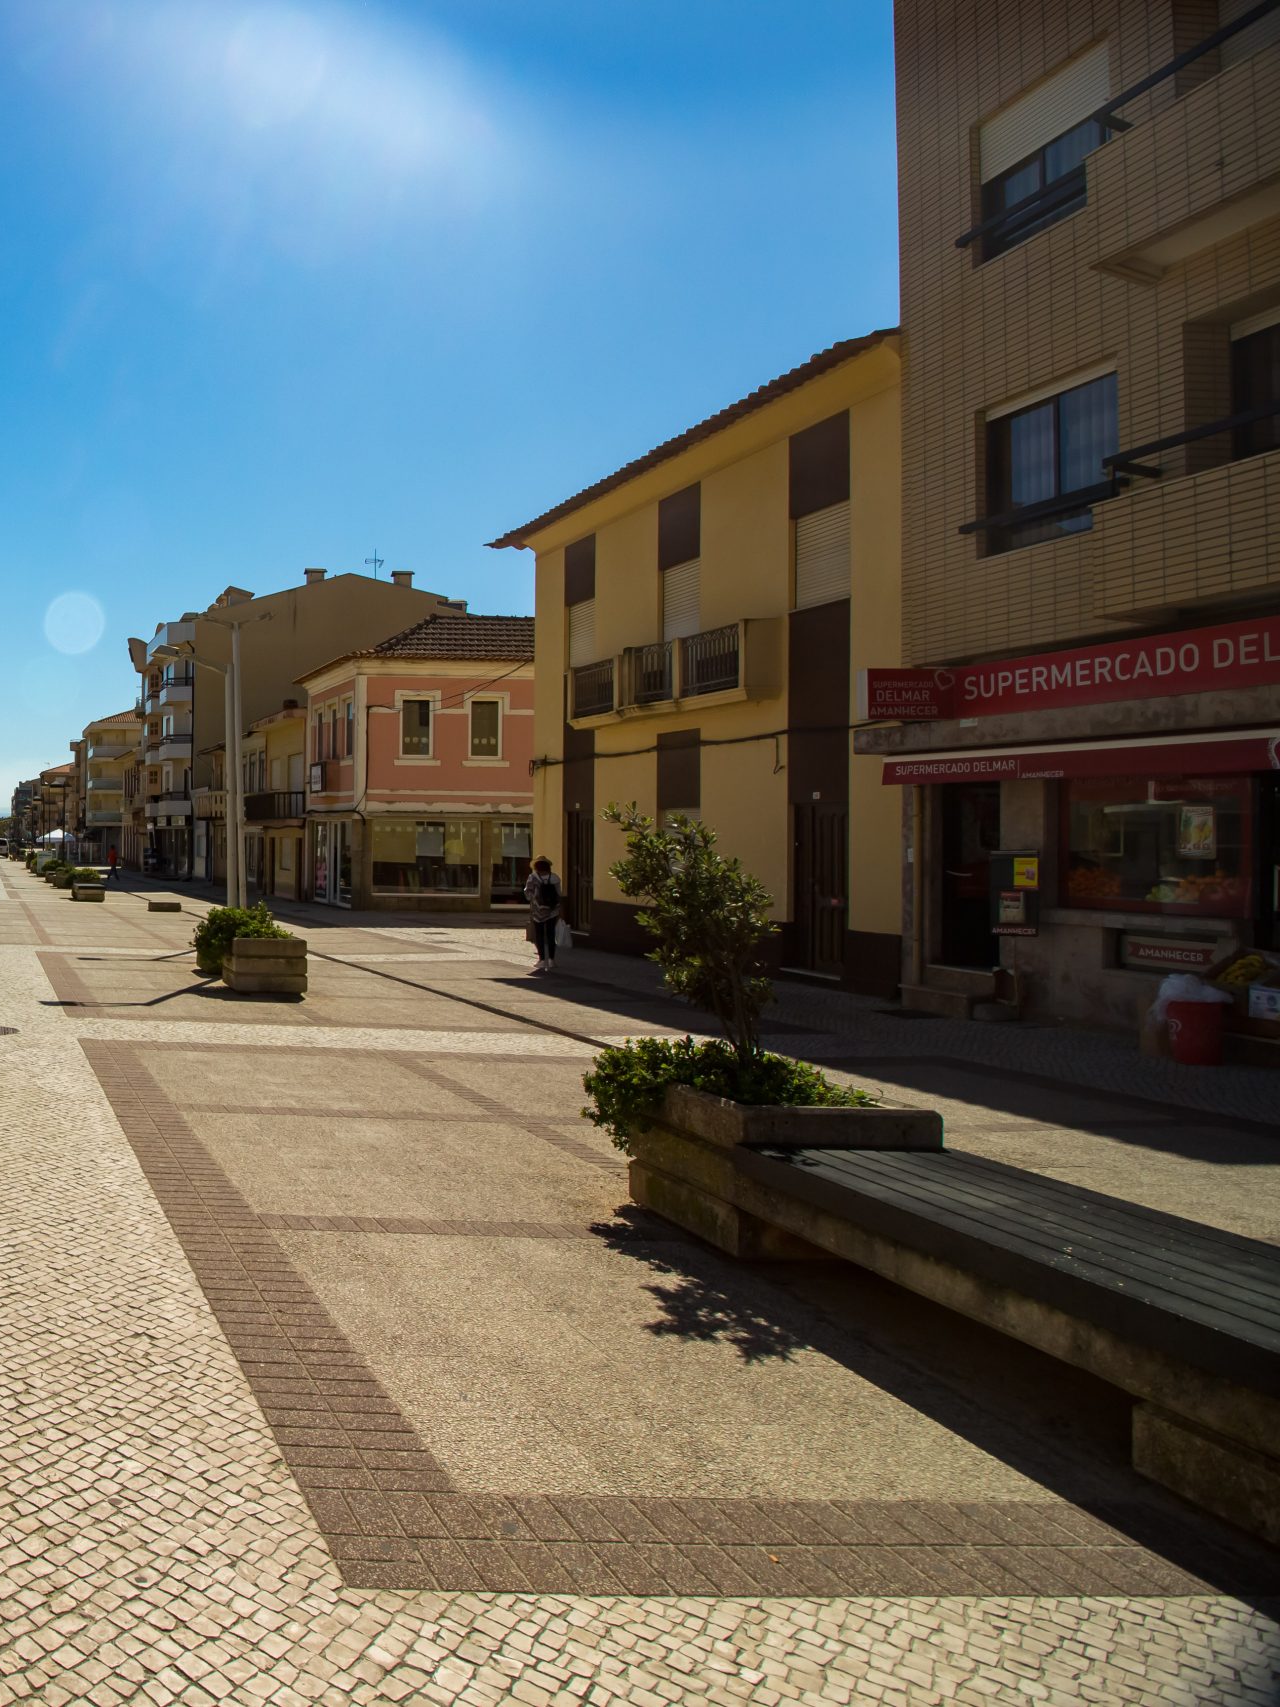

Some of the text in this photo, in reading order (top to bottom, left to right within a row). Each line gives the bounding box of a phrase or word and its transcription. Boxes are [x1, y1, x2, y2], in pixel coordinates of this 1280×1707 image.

[962, 632, 1280, 701] SUPERMERCADO DEL
[872, 680, 934, 689] SUPERMERCADO
[876, 690, 931, 702] DELMAR
[870, 705, 939, 716] AMANHECER
[895, 759, 1016, 776] SUPERMERCADO DELMAR
[1020, 770, 1065, 779] AMANHECER
[1137, 946, 1205, 963] AMANHECER
